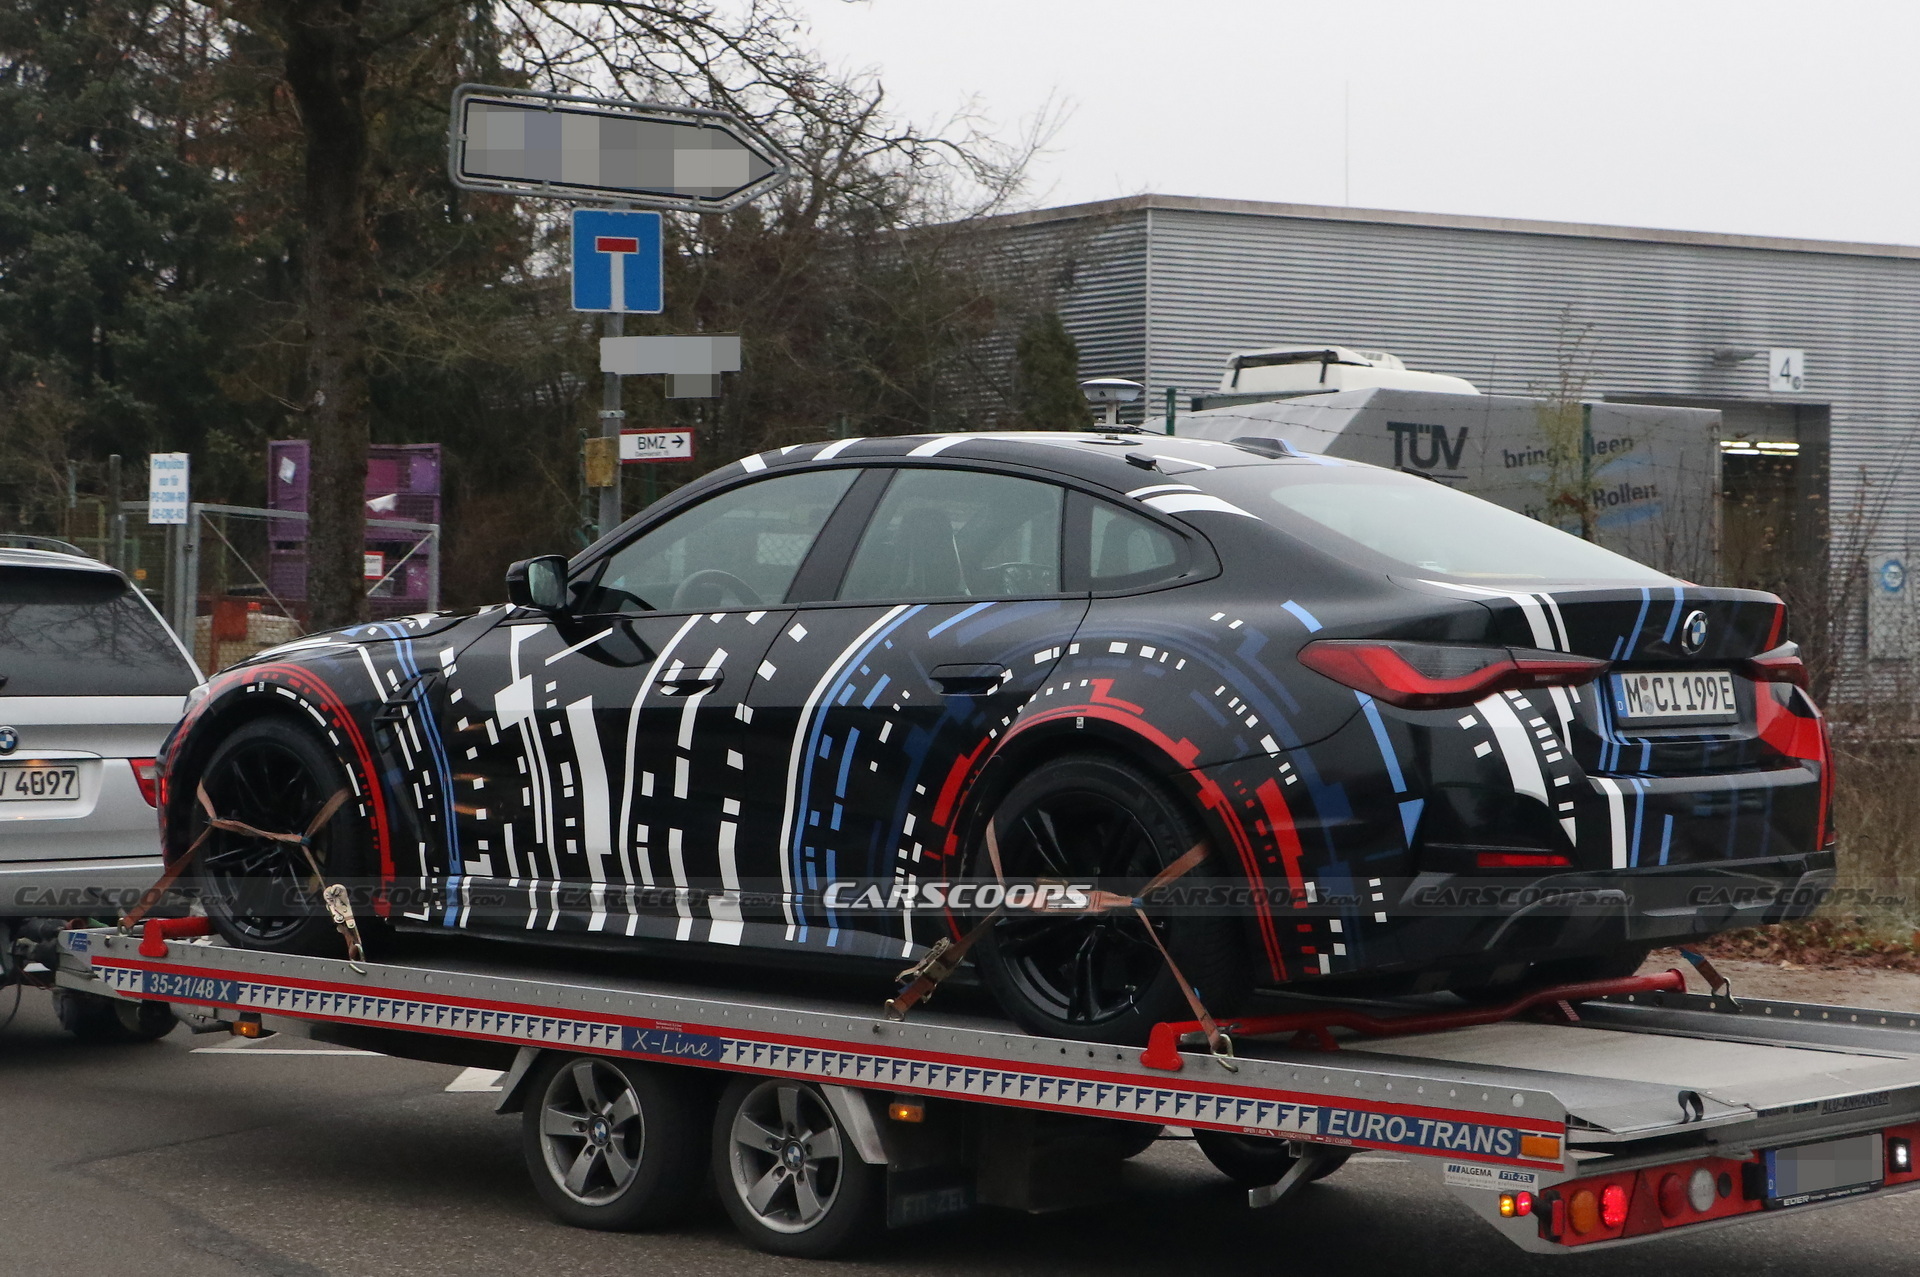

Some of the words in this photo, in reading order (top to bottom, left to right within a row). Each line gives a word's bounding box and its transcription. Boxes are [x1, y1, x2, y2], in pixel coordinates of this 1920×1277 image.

[1780, 357, 1791, 384] 4
[637, 435, 667, 450] BMZ
[1386, 421, 1469, 470] TÜV
[1592, 482, 1659, 509] Rollen
[150, 972, 215, 999] 35-21/48
[217, 981, 231, 1001] X
[631, 1027, 714, 1058] X-Line
[1326, 1109, 1514, 1156] EURO-TRANS
[1460, 1166, 1492, 1177] ALGEMA
[1502, 1171, 1532, 1182] FIT-ZEL
